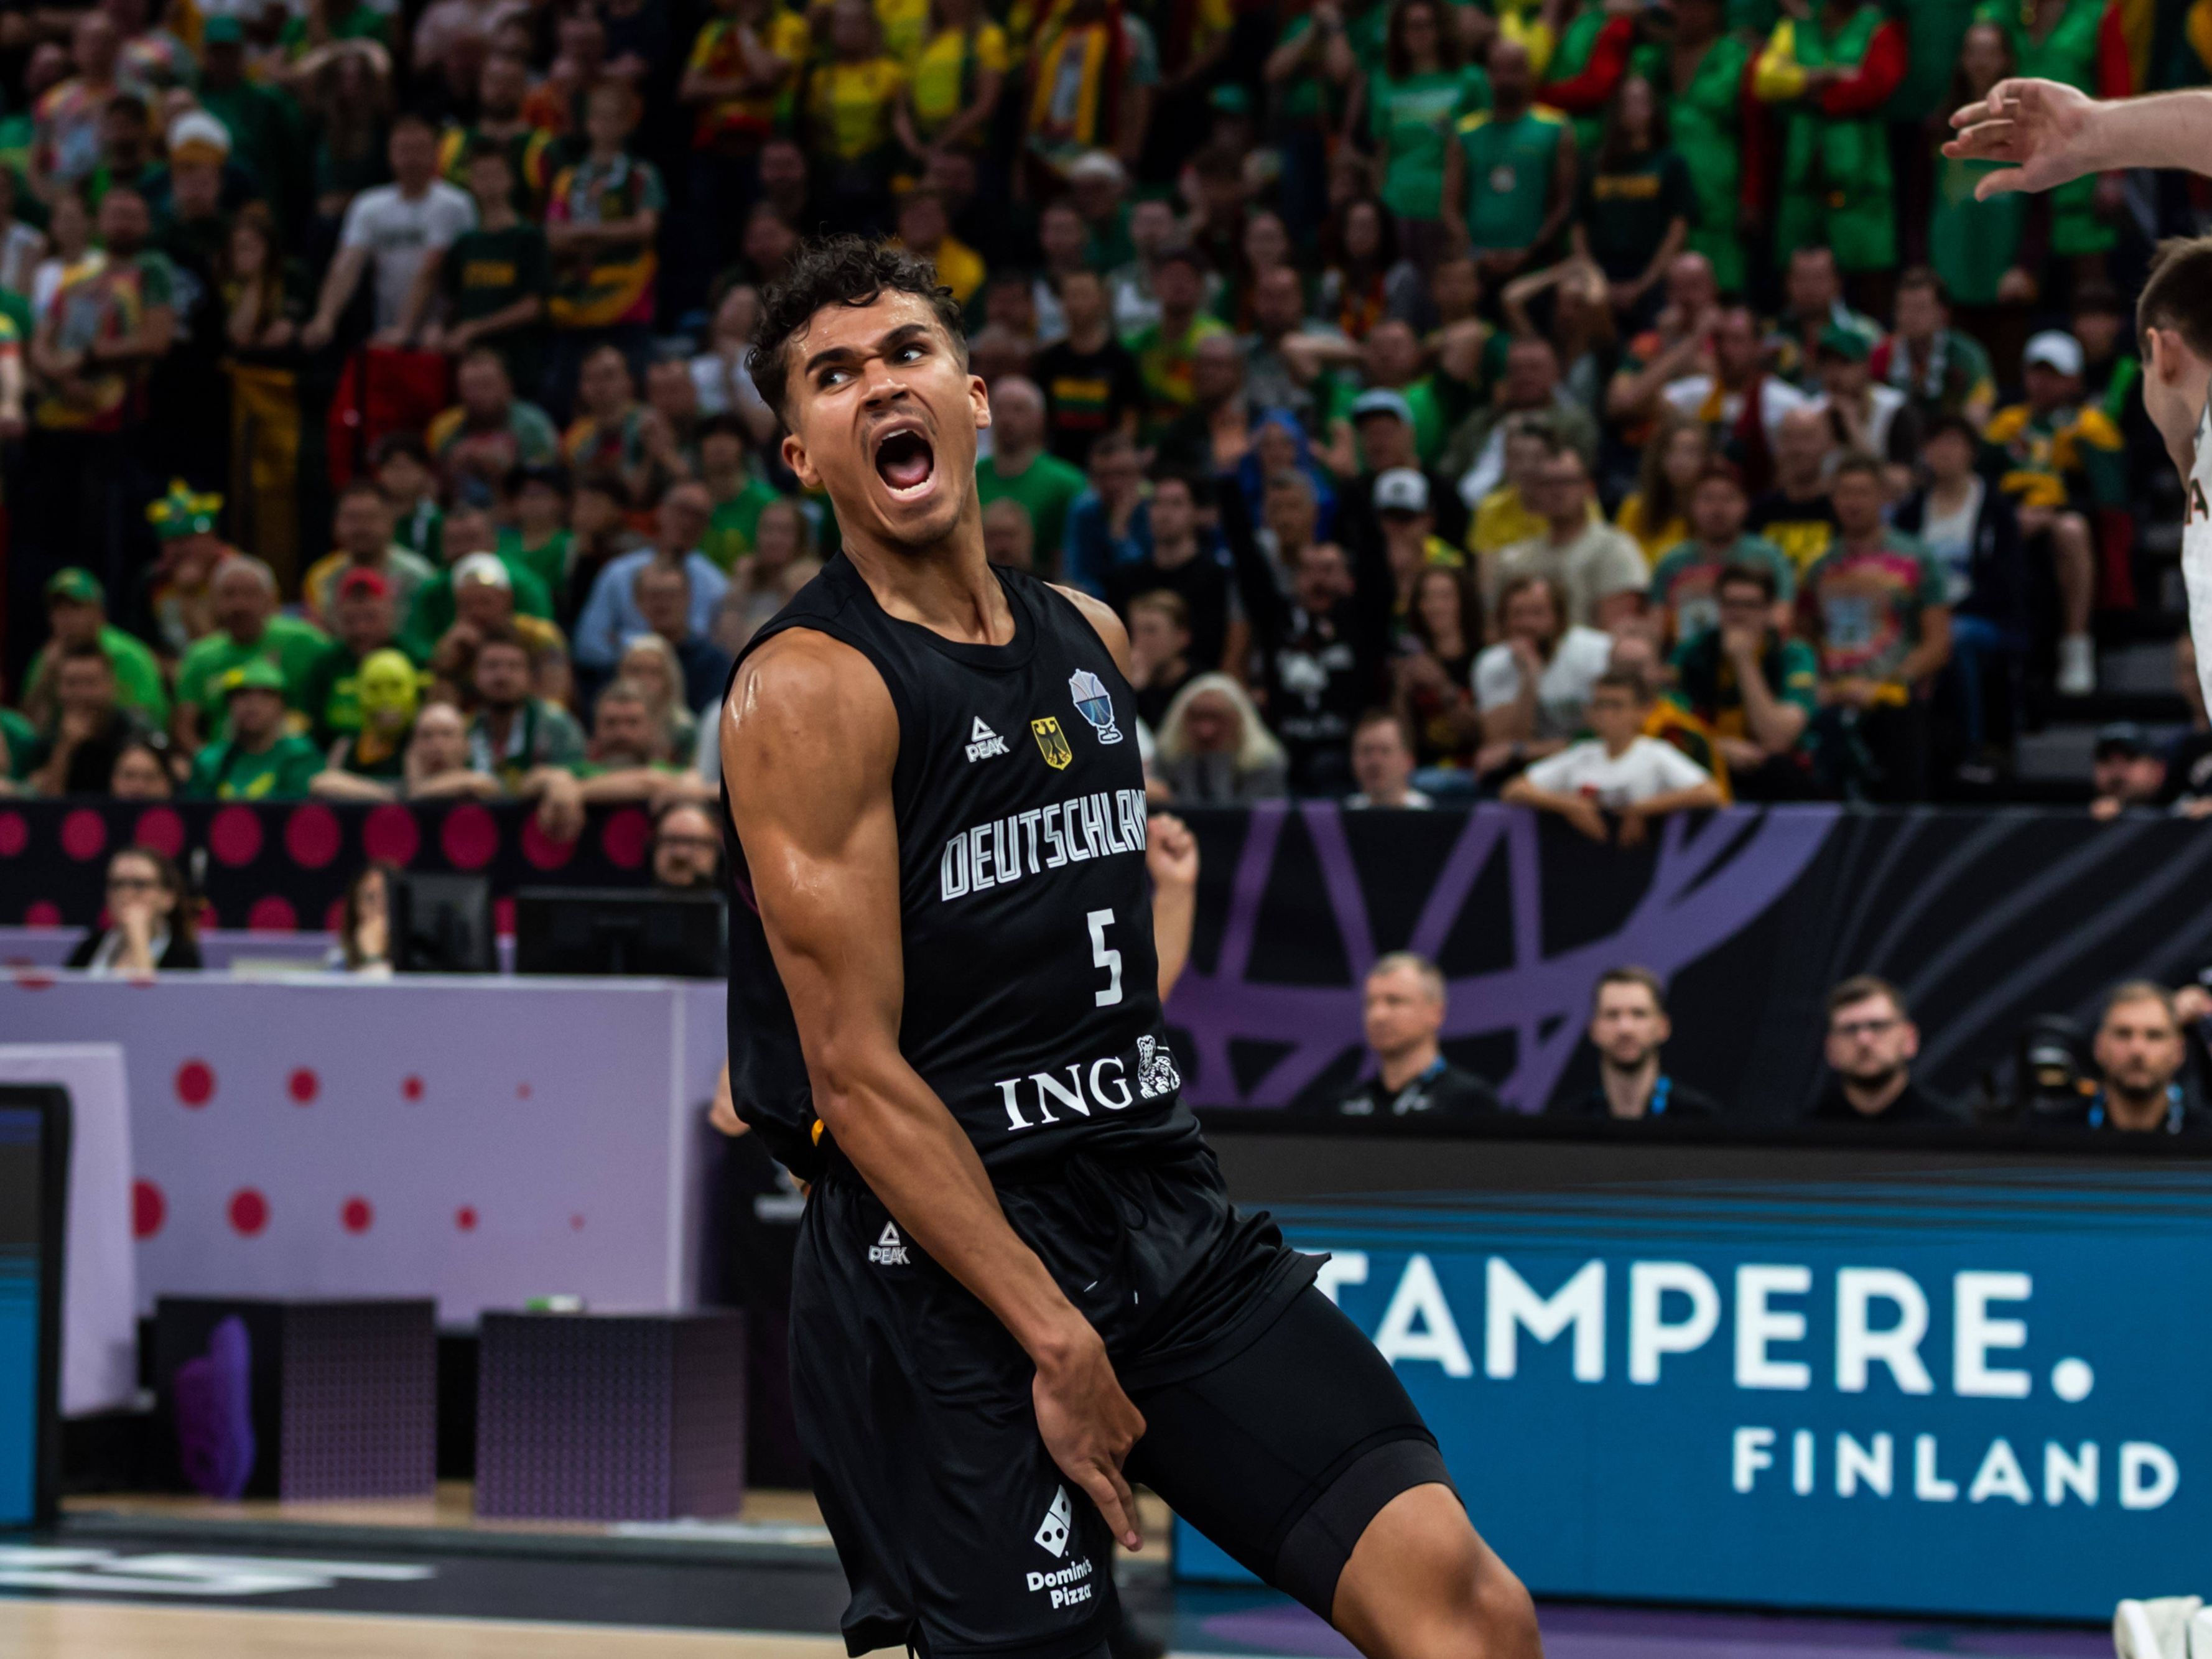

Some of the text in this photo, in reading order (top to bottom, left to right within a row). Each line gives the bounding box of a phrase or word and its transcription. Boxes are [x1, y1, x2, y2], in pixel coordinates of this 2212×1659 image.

[965, 735, 1011, 763] PEAK
[1087, 908, 1123, 1007] 5
[995, 1056, 1133, 1131] ING
[868, 1245, 911, 1265] PEAK
[1733, 1427, 2179, 1510] FINLAND
[1026, 1556, 1093, 1591] Domino's
[1050, 1583, 1092, 1609] Pizza
